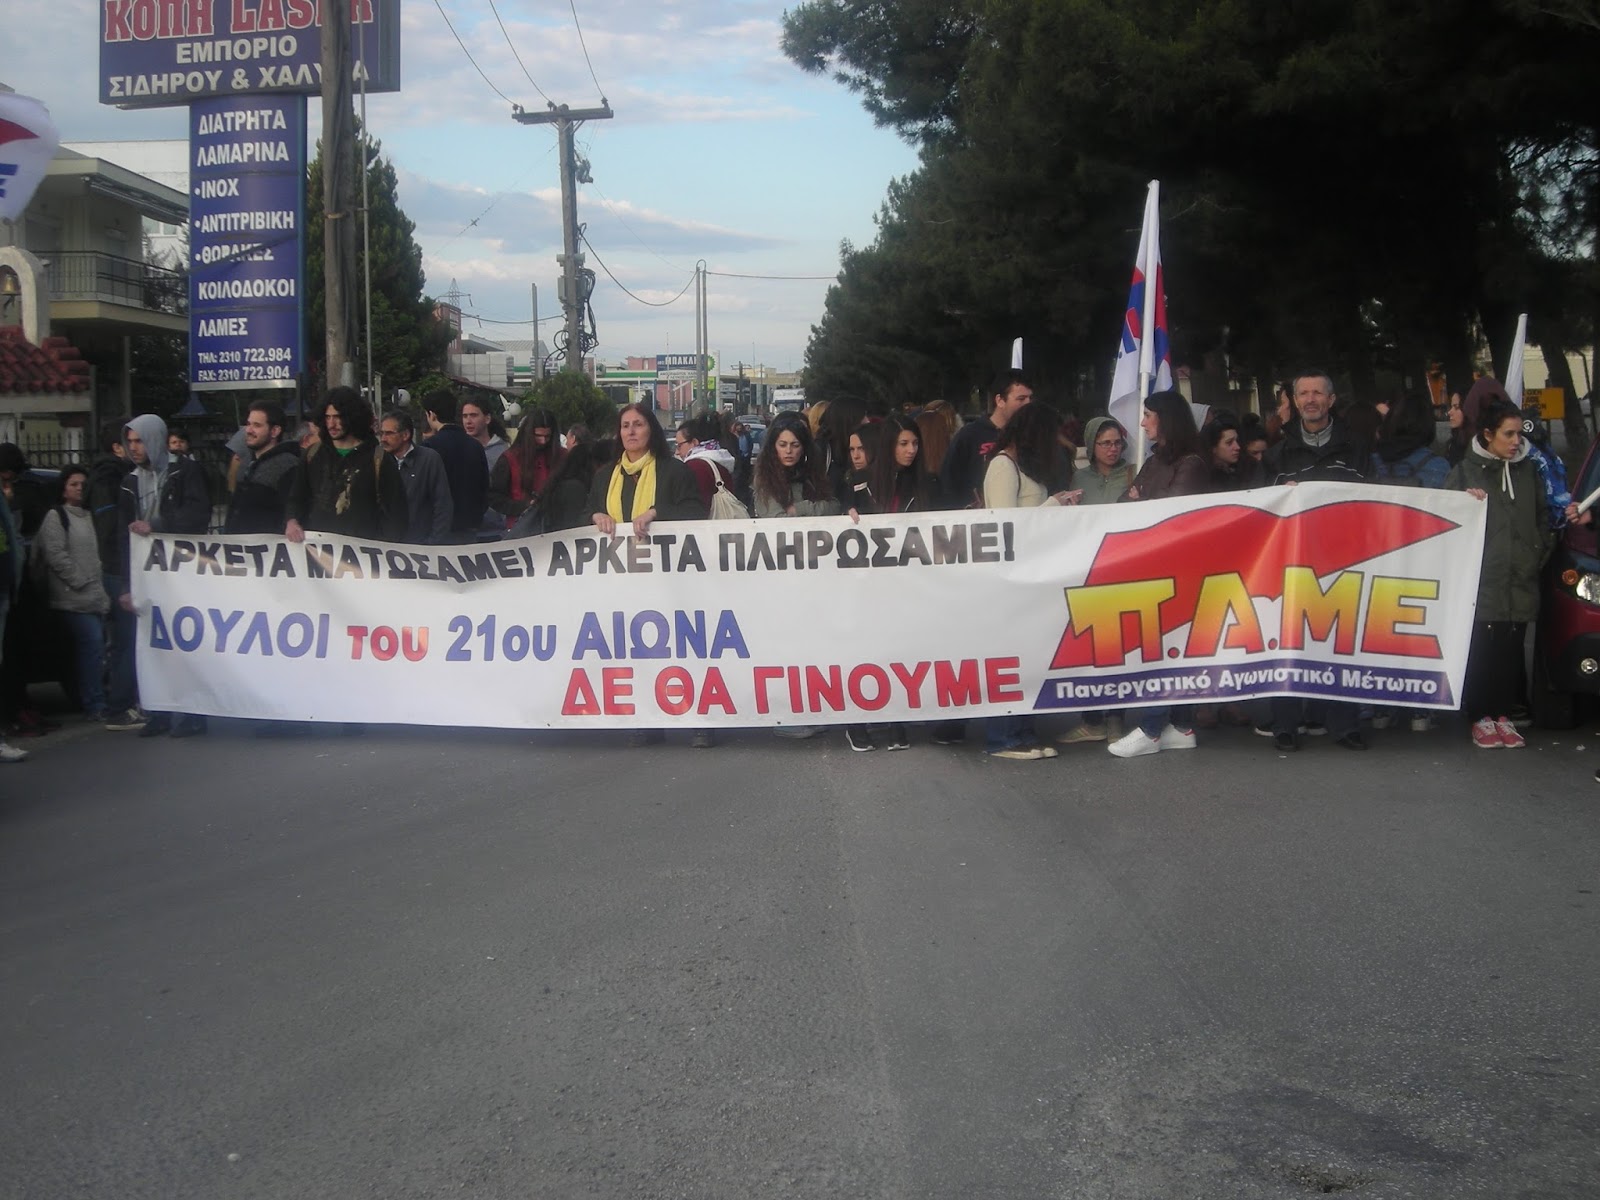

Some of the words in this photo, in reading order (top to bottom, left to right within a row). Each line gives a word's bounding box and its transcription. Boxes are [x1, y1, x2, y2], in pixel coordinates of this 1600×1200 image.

[230, 0, 373, 34] LASR
[176, 35, 297, 64] ΕΜΠΟΡΙΟ
[109, 70, 223, 97] ΣΙΔΗΡΟΥ
[231, 68, 250, 90] &
[258, 60, 370, 88] ΧΑΛΥΑ
[199, 109, 287, 135] ΔΙΑΤΡΗΤΑ
[197, 141, 289, 167] ΛΑΜΑΡΙΝΑ
[202, 178, 239, 199] INOX
[201, 210, 294, 233] ΑΝΤΙΤΡΙΒΙΚΗ
[198, 279, 295, 300] ΚΟΙΛΟΔΟΚΟΙ
[198, 317, 248, 337] ΛΑΜΕΣ
[219, 351, 241, 363] 2310
[243, 348, 291, 362] 722.984
[218, 369, 239, 380] 2310
[242, 365, 289, 379] 722.904
[143, 538, 296, 578] ΑΡΚΕΤΑ
[307, 543, 535, 584] ΜΑΤΩΣΑΜΕ!
[548, 534, 706, 577] ΑΡΚΕΤΑ
[719, 522, 1016, 572] ΠΛΗΡΩΣΑΜΕ!
[149, 605, 330, 659] ΔΟΥΛΟΙ
[572, 609, 750, 660] ΑΙΩΝΑ
[561, 666, 635, 716] ΔΕ
[654, 665, 737, 716] ΘΑ
[753, 656, 1024, 715] ΓΙΝΟΥΜΕ
[1056, 671, 1211, 700] Πανεργατικό
[1218, 665, 1336, 692] Αγωνιστικό
[1342, 670, 1437, 695] Μέτωπο
